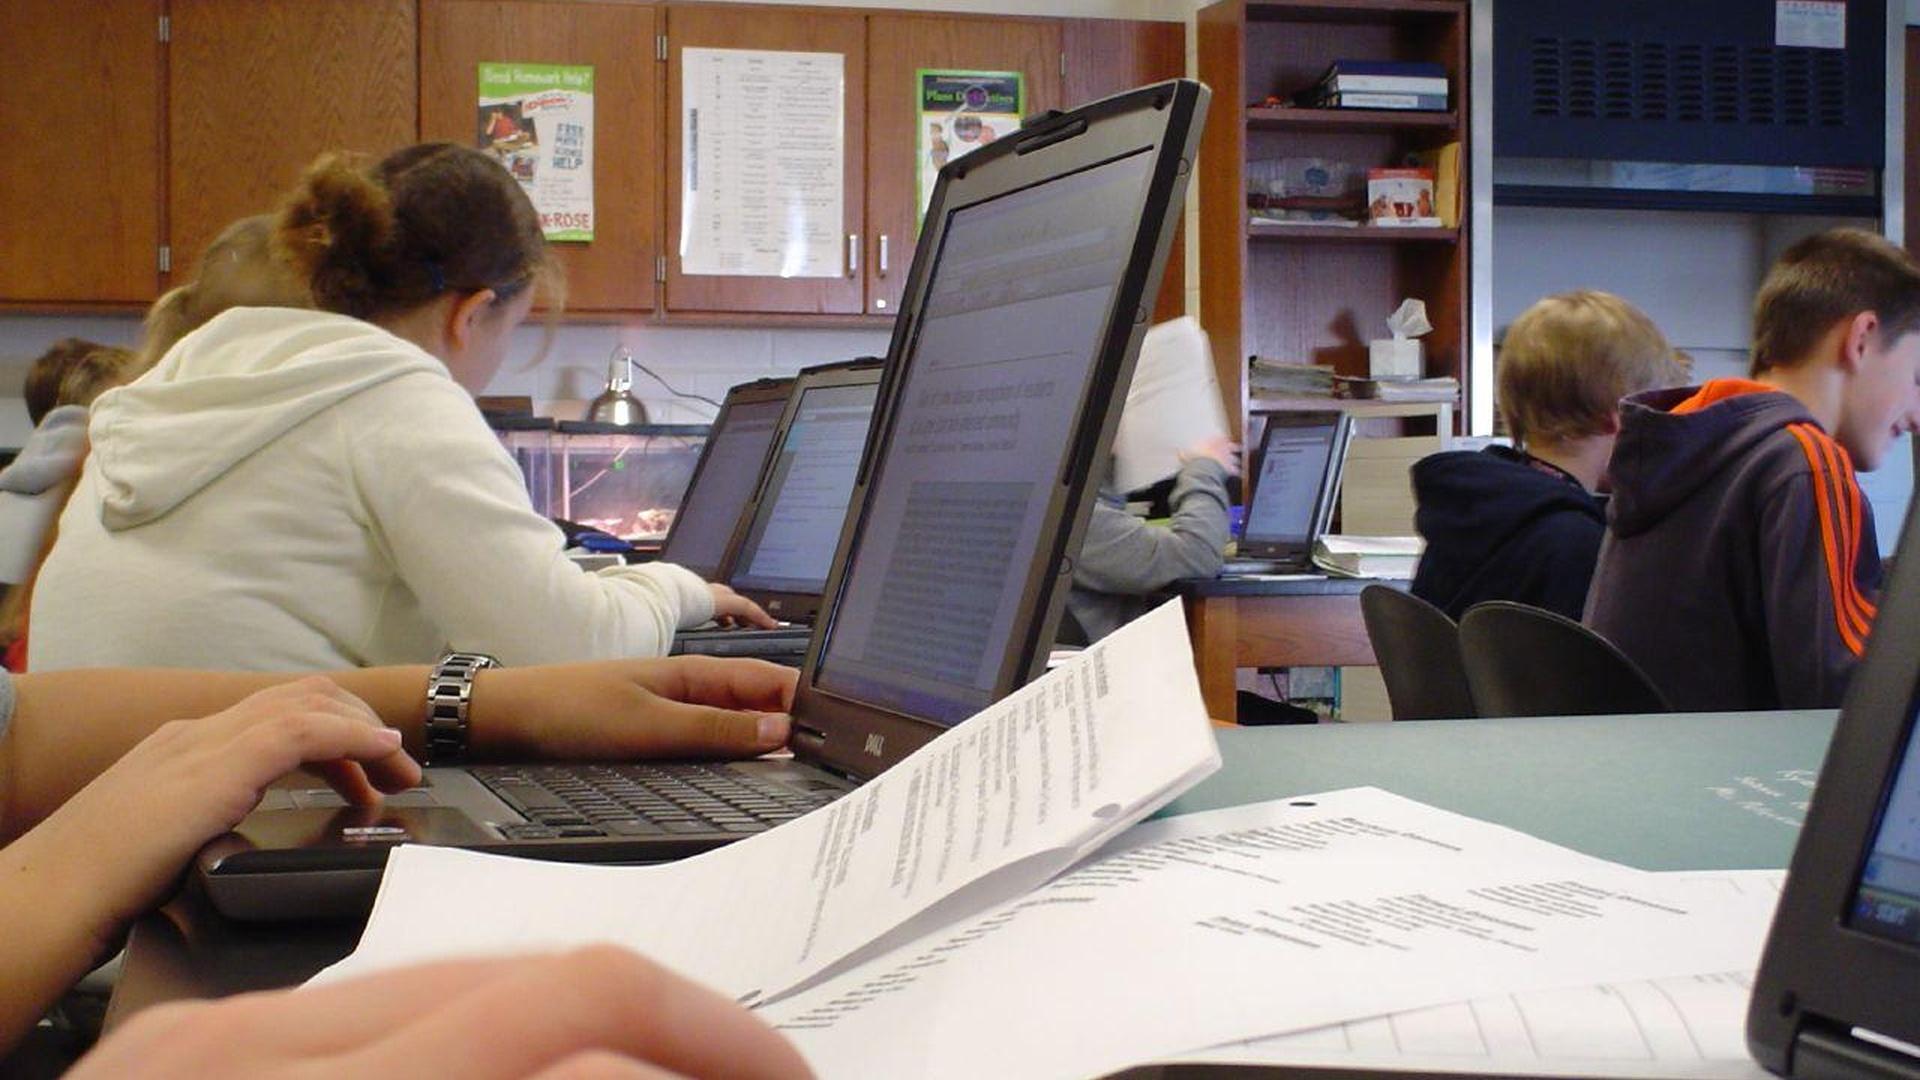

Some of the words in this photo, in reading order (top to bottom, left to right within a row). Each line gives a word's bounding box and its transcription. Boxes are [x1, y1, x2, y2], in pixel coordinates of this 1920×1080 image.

[553, 157, 584, 170] HELP
[537, 212, 591, 229] K-ROSE
[864, 733, 885, 757] DELL
